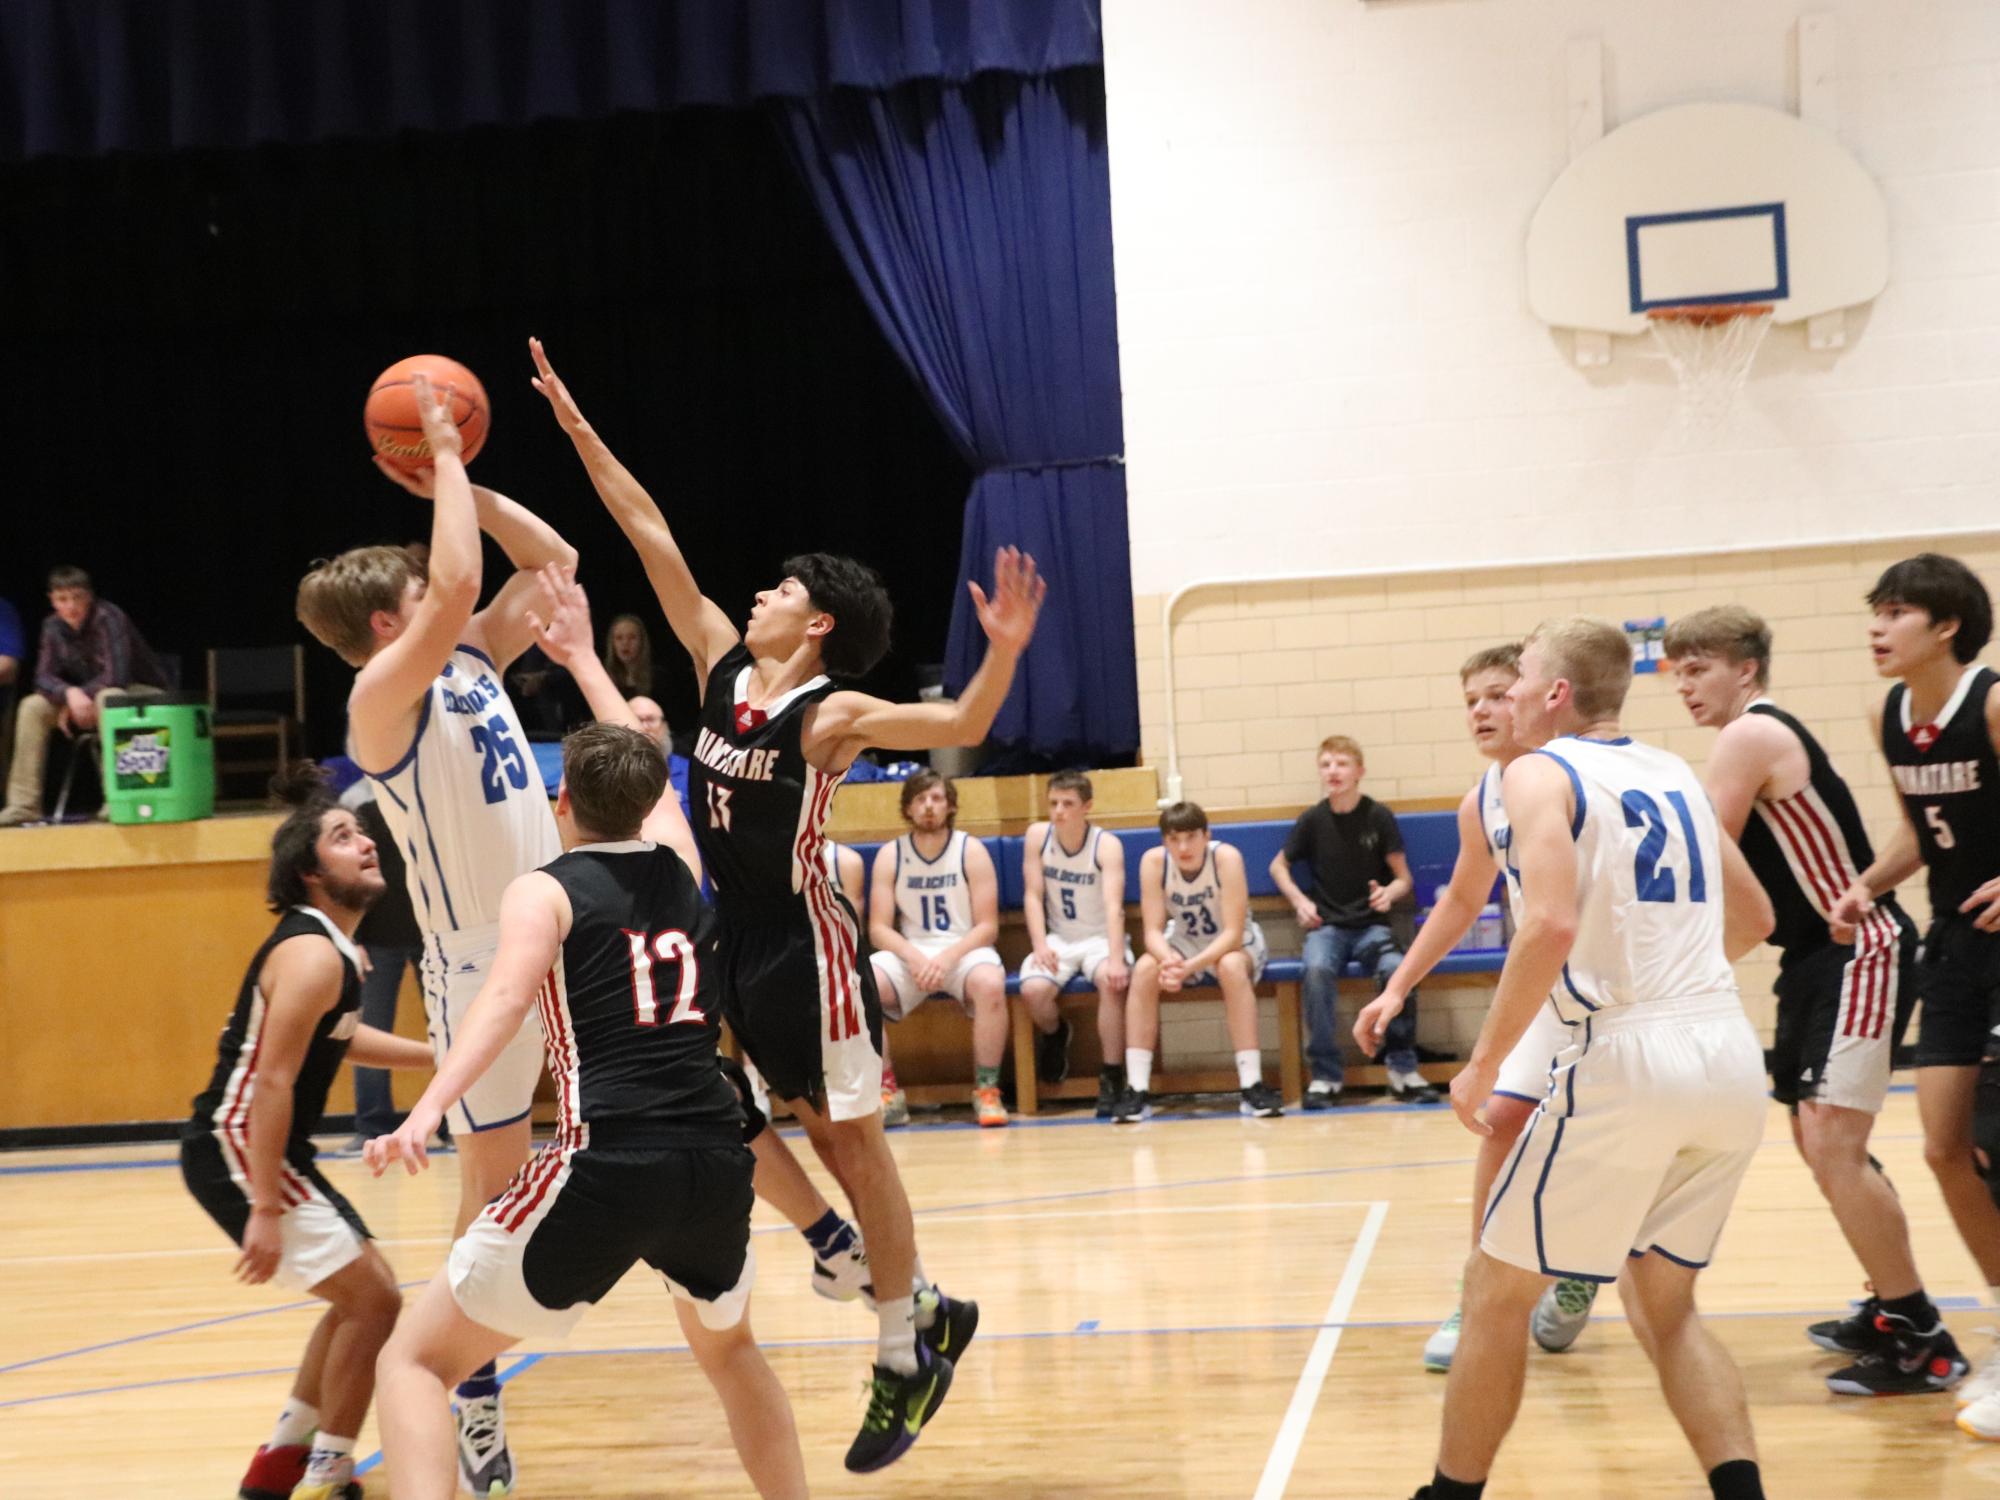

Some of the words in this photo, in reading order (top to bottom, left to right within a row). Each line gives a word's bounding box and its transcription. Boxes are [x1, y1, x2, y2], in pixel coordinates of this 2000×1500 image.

[469, 713, 528, 805] 25
[1620, 788, 1706, 903] 21
[1923, 806, 1956, 849] 5
[920, 895, 950, 931] 15
[1060, 888, 1076, 919] 5
[1181, 905, 1218, 936] 23
[619, 927, 708, 1026] 12
